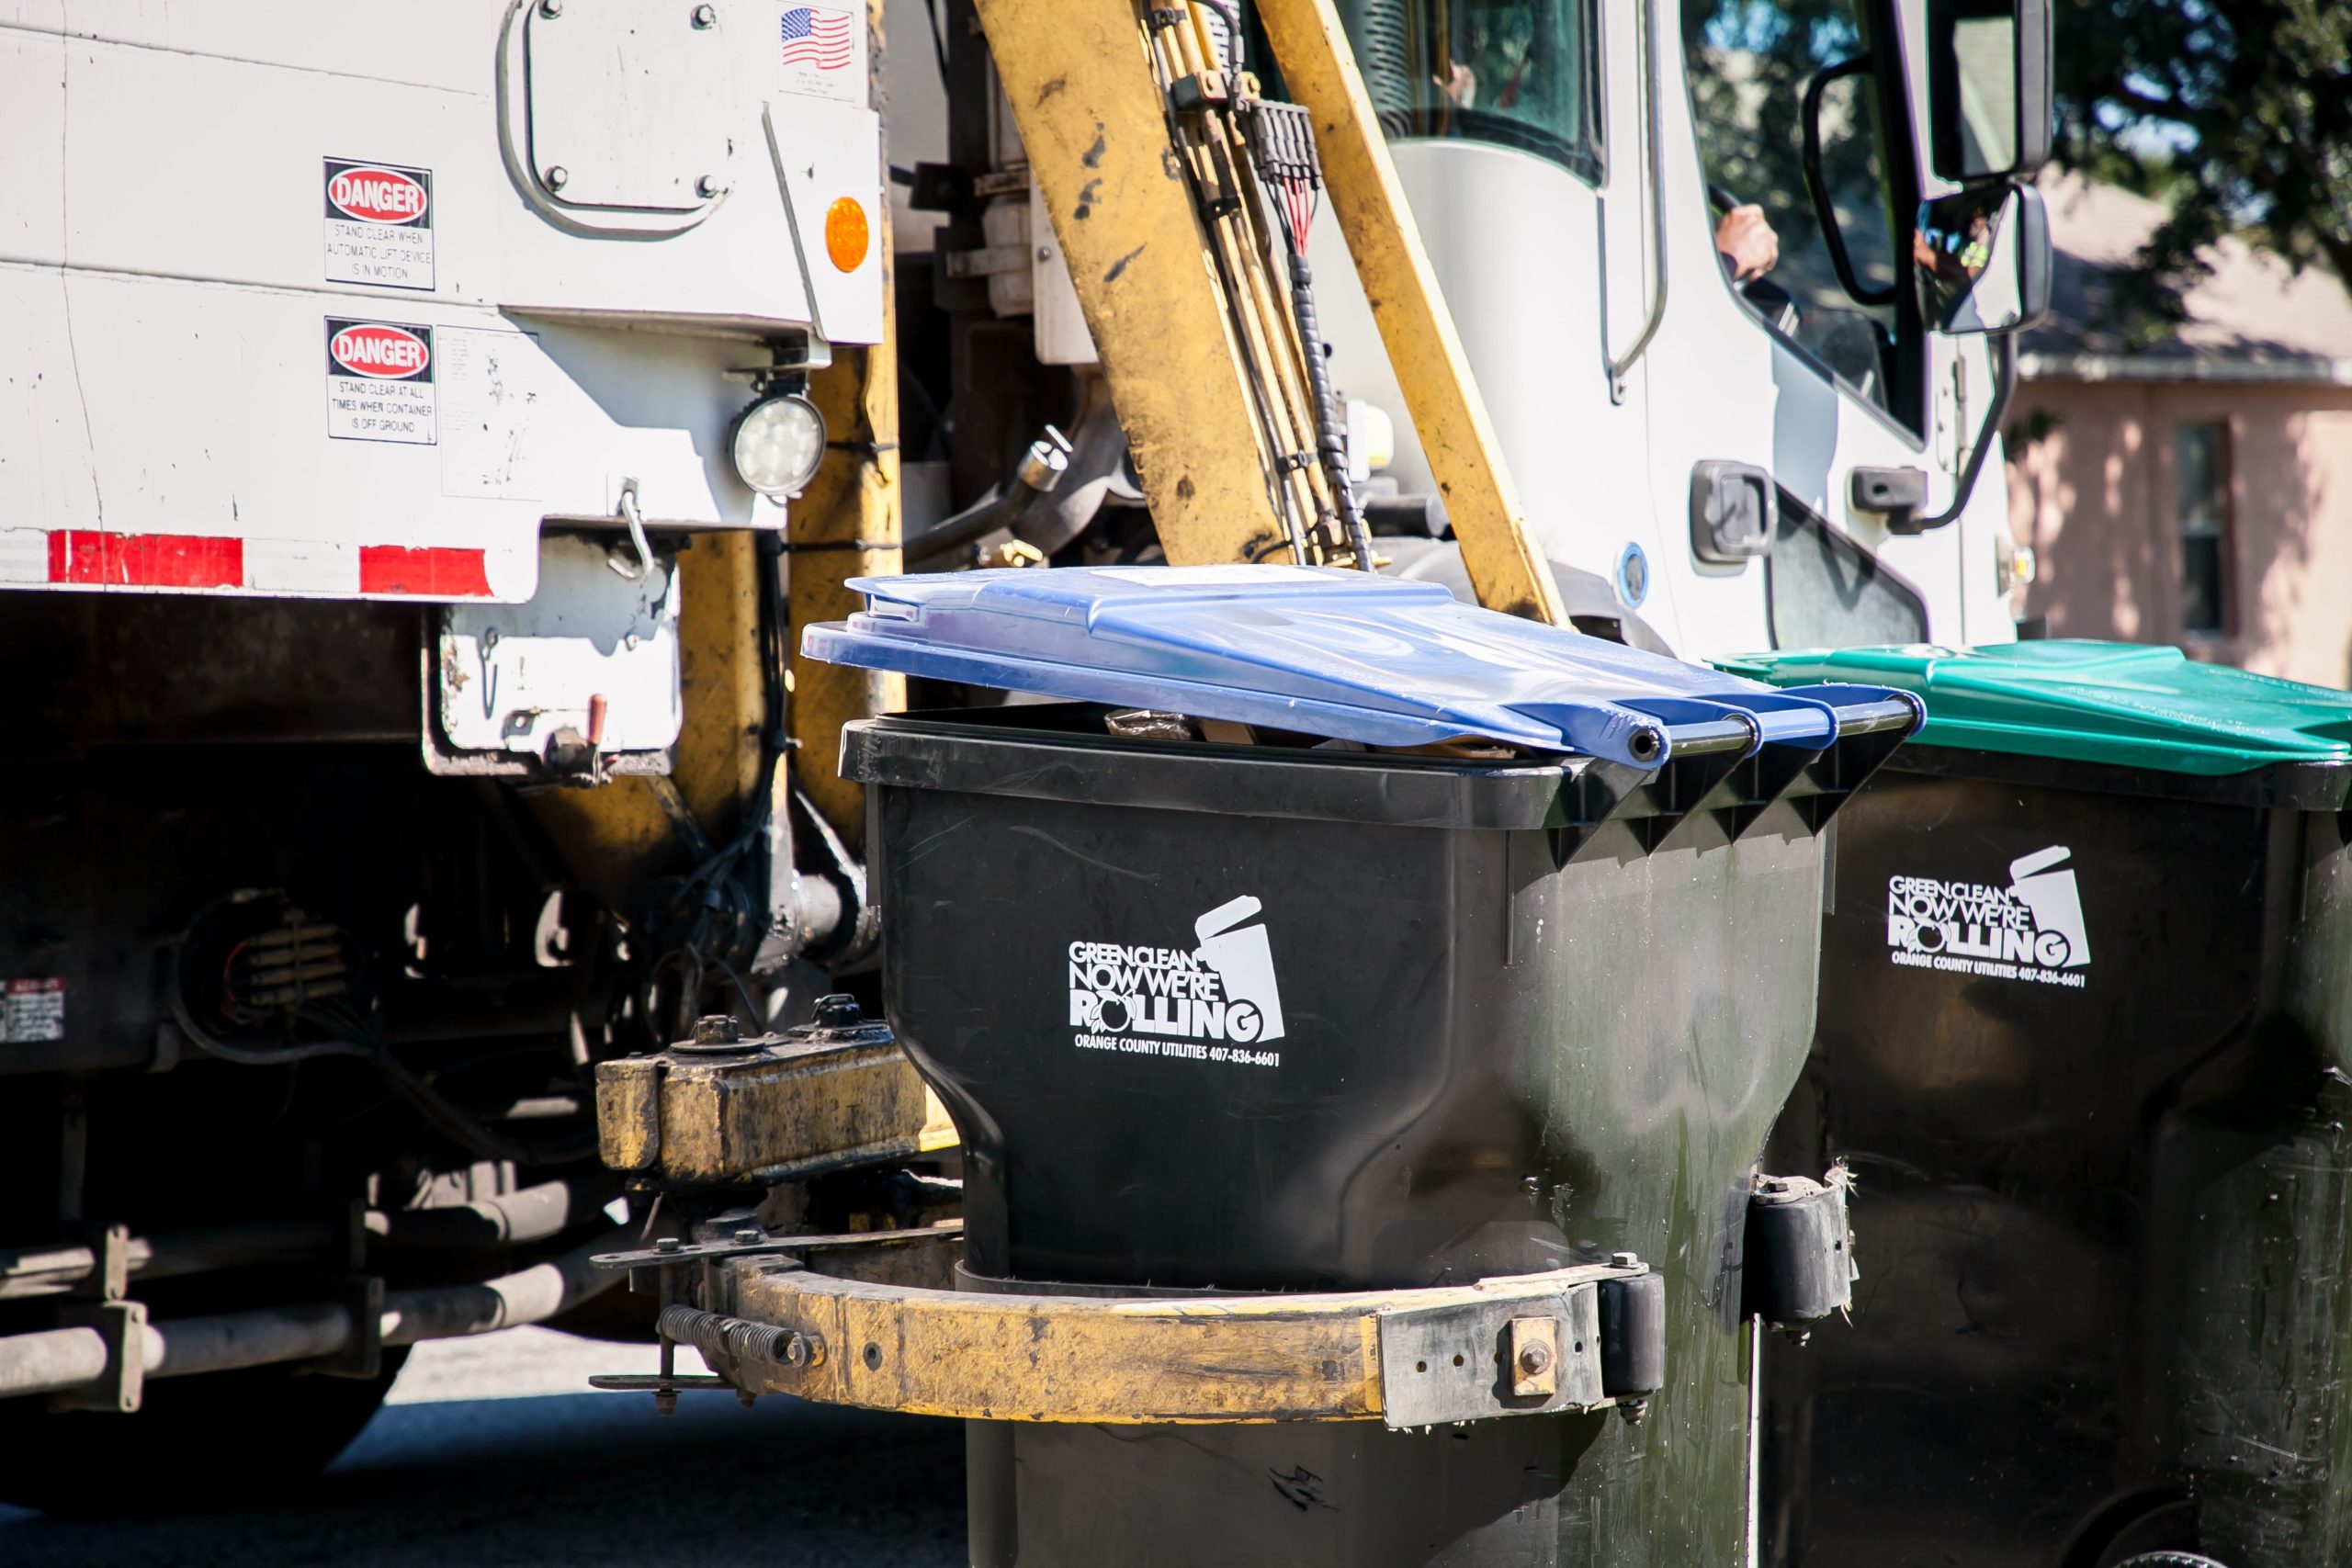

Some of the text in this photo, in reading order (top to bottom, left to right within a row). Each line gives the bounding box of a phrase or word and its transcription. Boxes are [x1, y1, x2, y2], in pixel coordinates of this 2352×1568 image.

[336, 176, 419, 214] DANGER
[334, 224, 424, 244] STAND CLEAR WHEN
[327, 243, 432, 265] AUTOMATIC LIFT DEVICE
[352, 263, 408, 279] IS IN MOTION
[338, 334, 422, 368] DANGER
[339, 381, 424, 399] STAND CLEAR AT ALL
[332, 399, 432, 416] TIMES WHEN CONTAINER
[351, 417, 415, 434] IS OFF GROUND
[1889, 891, 2030, 931] NOW WE'RE
[1888, 915, 2069, 967] ROLLING
[1069, 960, 1220, 1001] NOW WE'RE
[1891, 951, 2086, 988] ORANGE COUNTY UTILITIES 407-836-6601
[1069, 988, 1261, 1043] ROLLING
[1074, 1033, 1280, 1067] ORANGE COUNTY UTILITIES 407-836-6601
